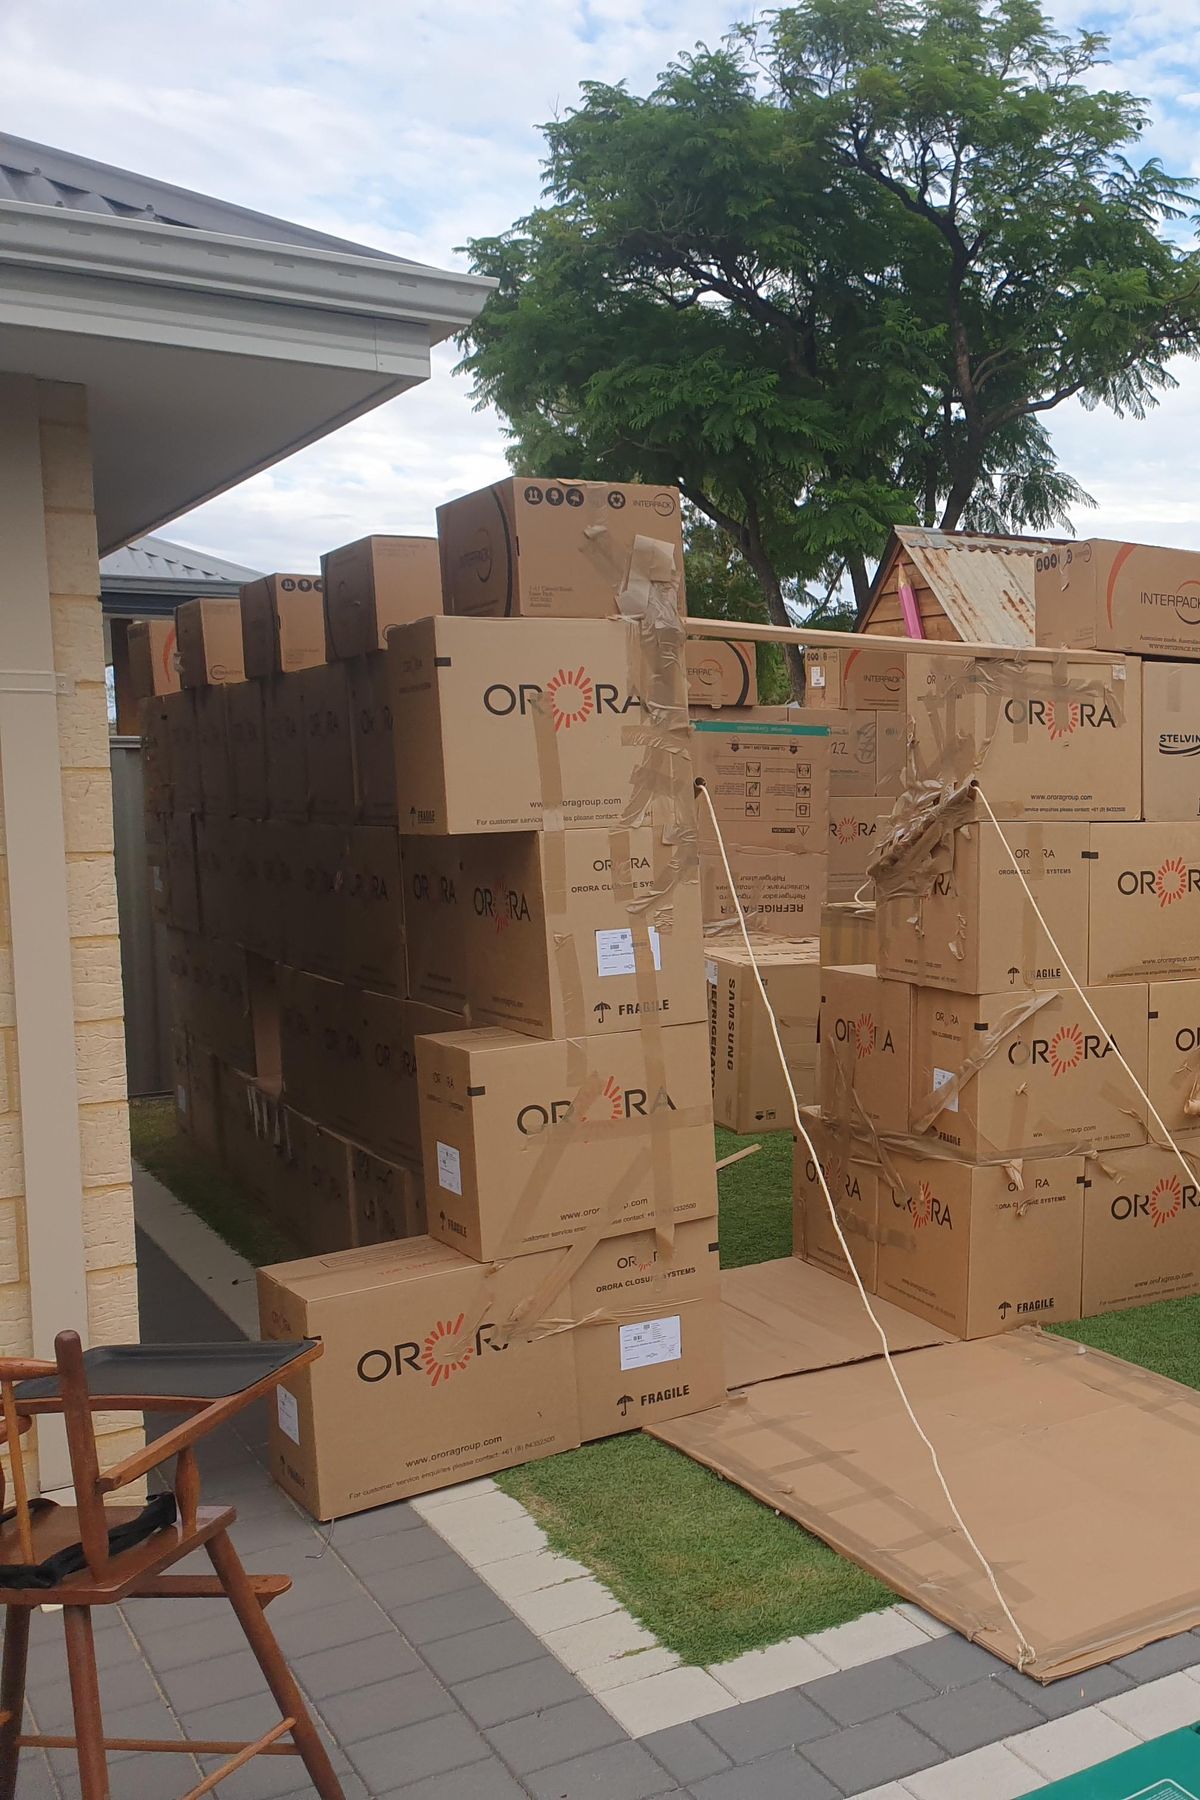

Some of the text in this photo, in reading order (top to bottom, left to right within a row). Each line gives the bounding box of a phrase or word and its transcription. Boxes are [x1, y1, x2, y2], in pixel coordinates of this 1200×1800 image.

[1004, 698, 1117, 740] ORORA
[829, 816, 877, 844] RORA
[1015, 848, 1056, 859] ORRA
[593, 857, 651, 871] ORRA
[571, 885, 599, 893] ORORA
[1142, 955, 1200, 966] www.ororagroup.com
[727, 977, 736, 1072] SAMSUNG
[936, 1011, 960, 1025] ORRA
[1008, 1023, 1120, 1076] ORORA
[1040, 1195, 1067, 1204] SYSTEMS
[596, 1282, 623, 1293] ORORA
[1017, 1297, 1055, 1313] FRAGILE
[640, 1384, 690, 1406] FRAGILE
[405, 1435, 503, 1469] www.ororagroup.com
[349, 1491, 361, 1500] For
[363, 1482, 395, 1497] customer
[396, 1475, 420, 1487] service
[421, 1466, 451, 1479] enquiries
[452, 1459, 474, 1472] please
